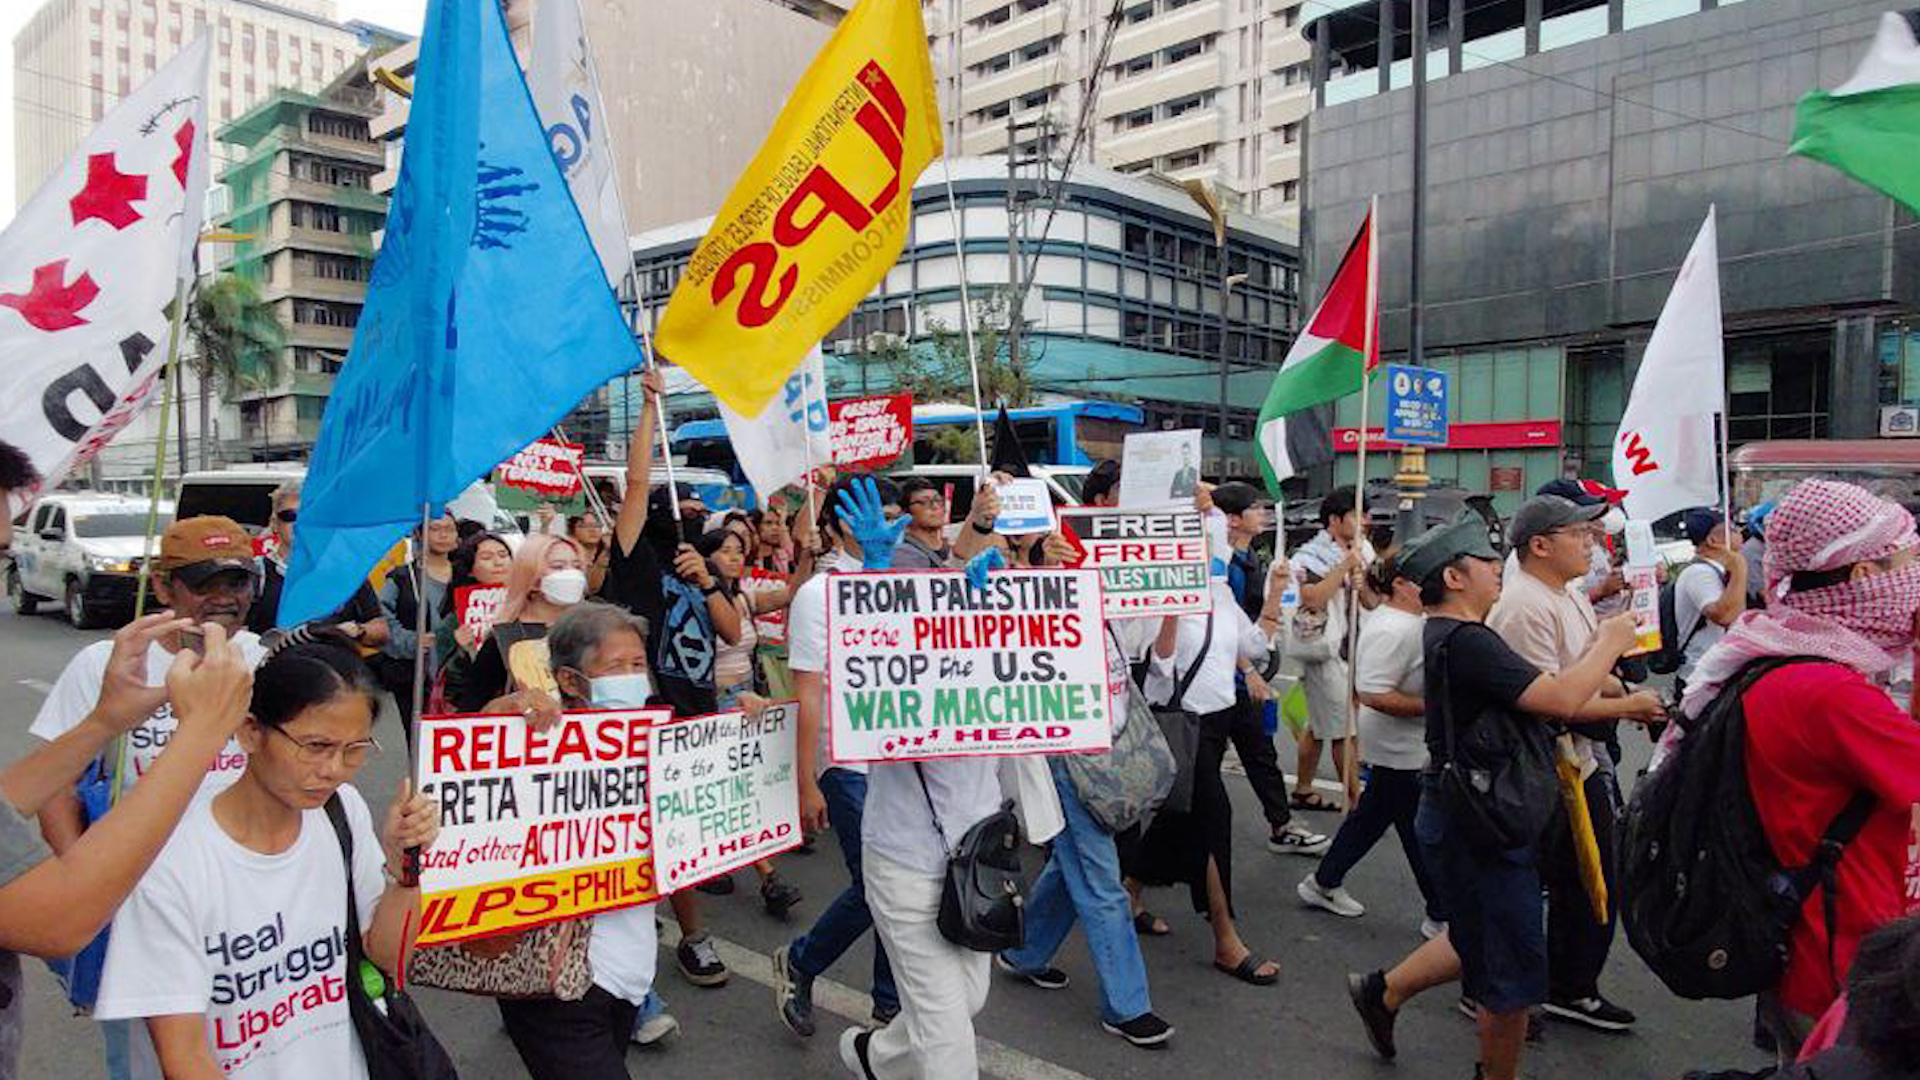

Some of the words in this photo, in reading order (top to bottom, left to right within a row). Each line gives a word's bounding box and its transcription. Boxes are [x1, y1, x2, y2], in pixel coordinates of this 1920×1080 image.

[1092, 515, 1202, 537] FREE
[1094, 544, 1202, 562] FREE
[838, 578, 919, 615] FROM
[931, 576, 1079, 611] PALESTINE
[1102, 566, 1206, 588] ALESTINE!
[1121, 596, 1199, 607] HEAD
[842, 627, 866, 647] to
[870, 623, 899, 647] the
[914, 613, 1082, 650] PHILIPPINES
[846, 654, 929, 688] STOP
[940, 656, 975, 679] the
[993, 651, 1067, 682] U.S.
[844, 690, 923, 731] WAR
[933, 684, 1104, 726] MACHINE!
[433, 719, 652, 773] RELEASE
[658, 721, 718, 756] FROM
[739, 708, 787, 741] RIVER
[955, 727, 1071, 742] HEAD
[728, 741, 764, 771] SEA
[532, 766, 649, 816] THUNBER
[656, 771, 755, 824] PALESTINE
[467, 836, 522, 864] other
[520, 812, 652, 868] ACTIVISTS
[700, 801, 762, 843] FREE!
[719, 823, 791, 856] HEAD
[205, 912, 284, 966] Heal
[215, 974, 346, 1049] Liberat
